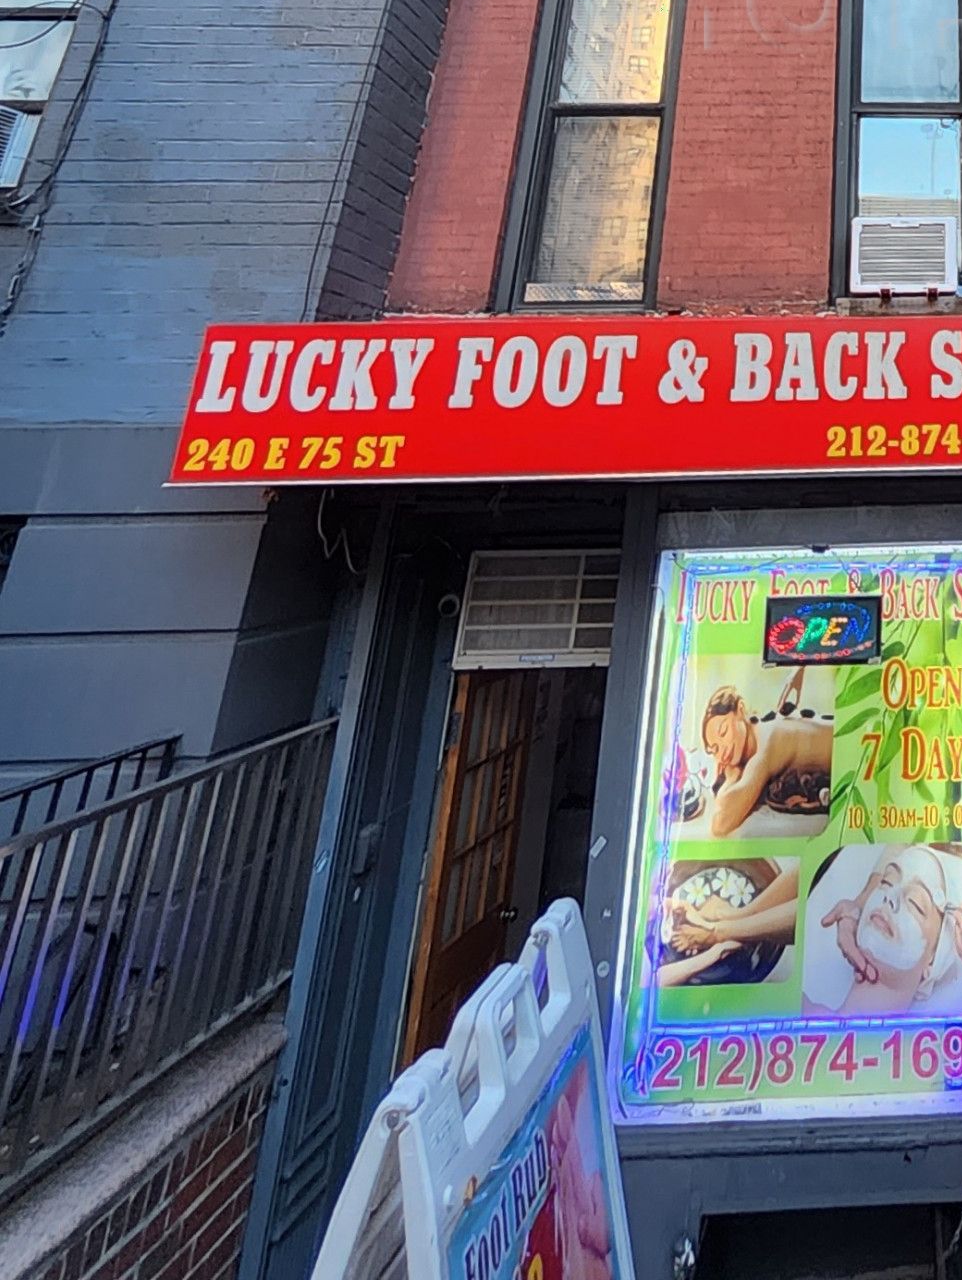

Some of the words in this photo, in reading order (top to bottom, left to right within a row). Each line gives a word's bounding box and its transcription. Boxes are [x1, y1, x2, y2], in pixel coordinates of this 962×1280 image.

[195, 337, 435, 413] LUCKY
[447, 334, 639, 409] FOOT
[657, 338, 709, 405] &
[729, 330, 908, 402] BACK
[183, 437, 255, 472] 240
[263, 437, 290, 471] E
[299, 436, 343, 470] 75
[353, 435, 405, 469] ST
[769, 615, 871, 655] OPEN
[861, 733, 882, 782] 7
